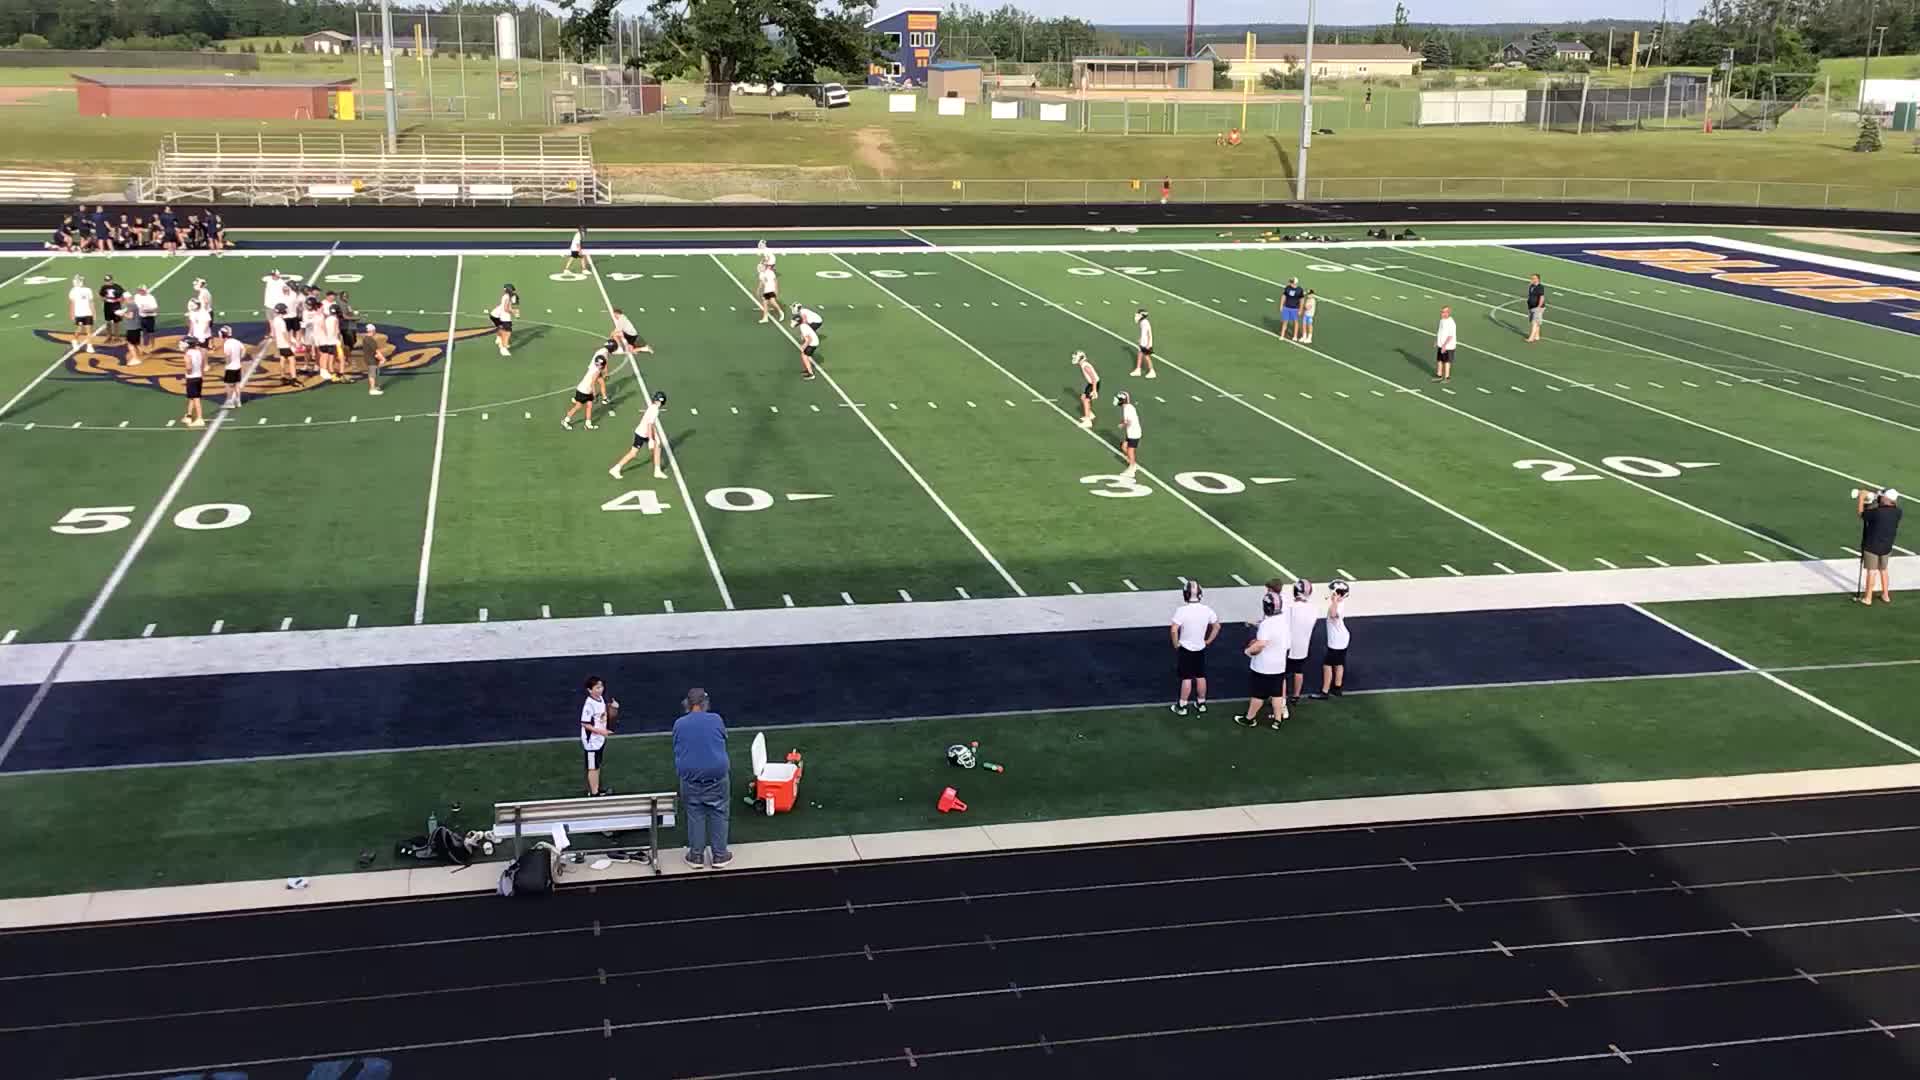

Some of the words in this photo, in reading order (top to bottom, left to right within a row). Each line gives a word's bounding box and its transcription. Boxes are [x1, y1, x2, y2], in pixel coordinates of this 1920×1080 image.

[548, 270, 643, 281] 40
[815, 268, 908, 279] 30
[1067, 266, 1158, 276] 20
[1513, 456, 1681, 481] 20
[1080, 471, 1246, 497] 30
[600, 487, 776, 515] 40
[51, 503, 252, 534] 50
